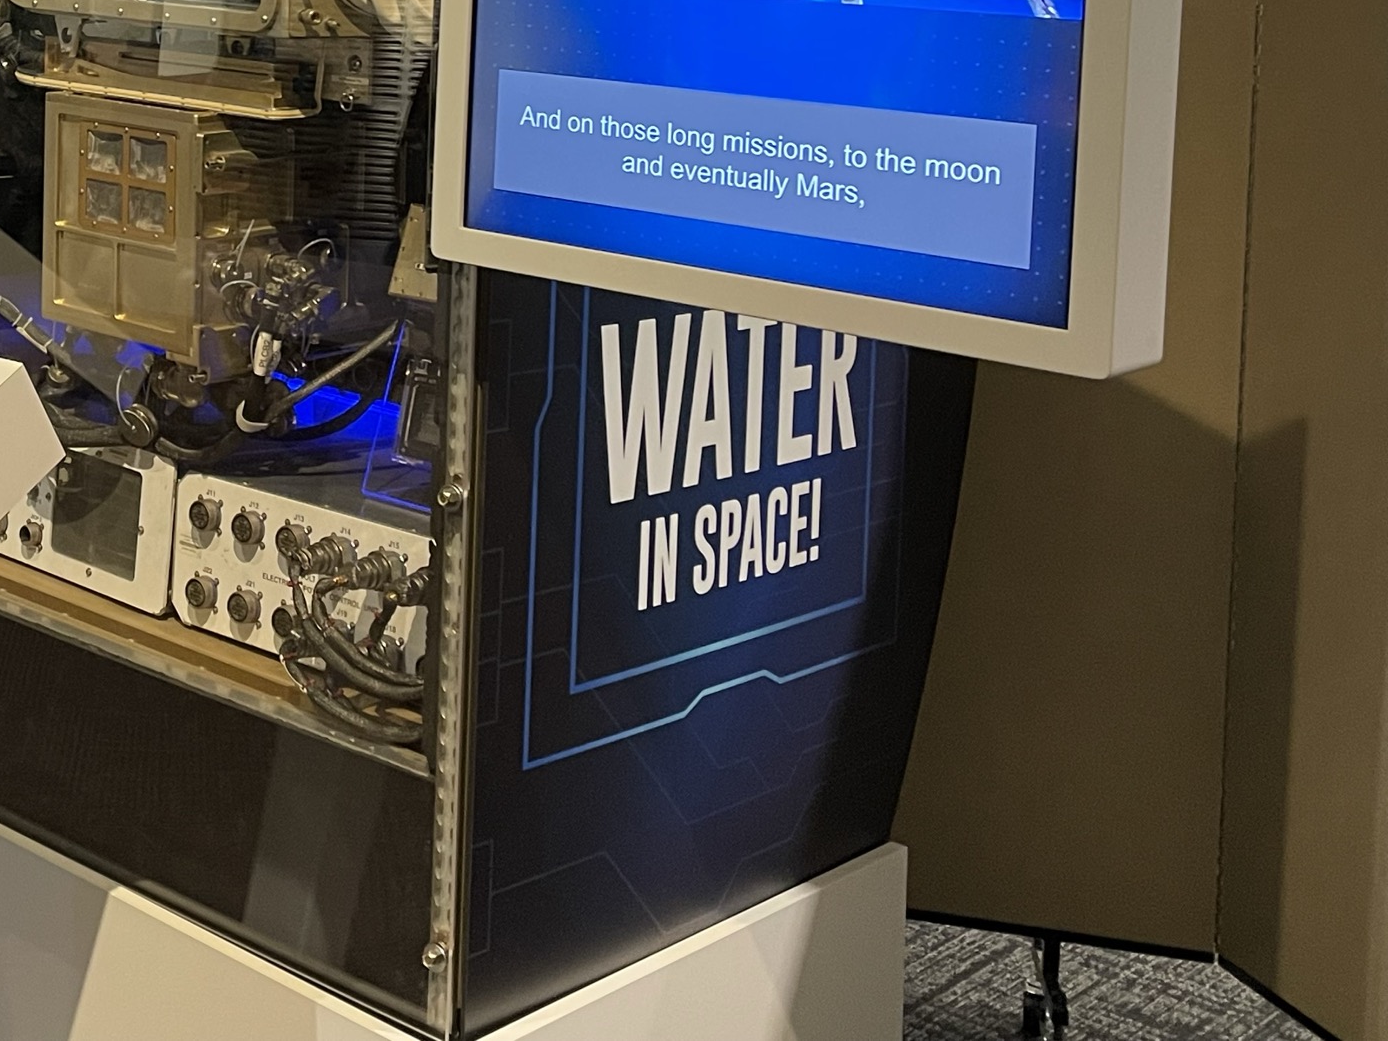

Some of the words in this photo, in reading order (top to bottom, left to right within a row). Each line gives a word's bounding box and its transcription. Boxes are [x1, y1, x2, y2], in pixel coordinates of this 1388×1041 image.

[519, 105, 562, 131] And
[567, 115, 594, 135] on
[600, 115, 661, 144] those
[666, 122, 716, 156] long
[722, 130, 836, 168] missions,
[844, 144, 869, 169] to
[875, 148, 917, 175] the
[924, 158, 1002, 186] moon
[621, 153, 664, 178] and
[670, 160, 790, 200] eventually
[796, 171, 866, 209] Mars,
[600, 309, 858, 504] WATER
[637, 513, 679, 611] IN
[692, 477, 822, 595] SPACE!
